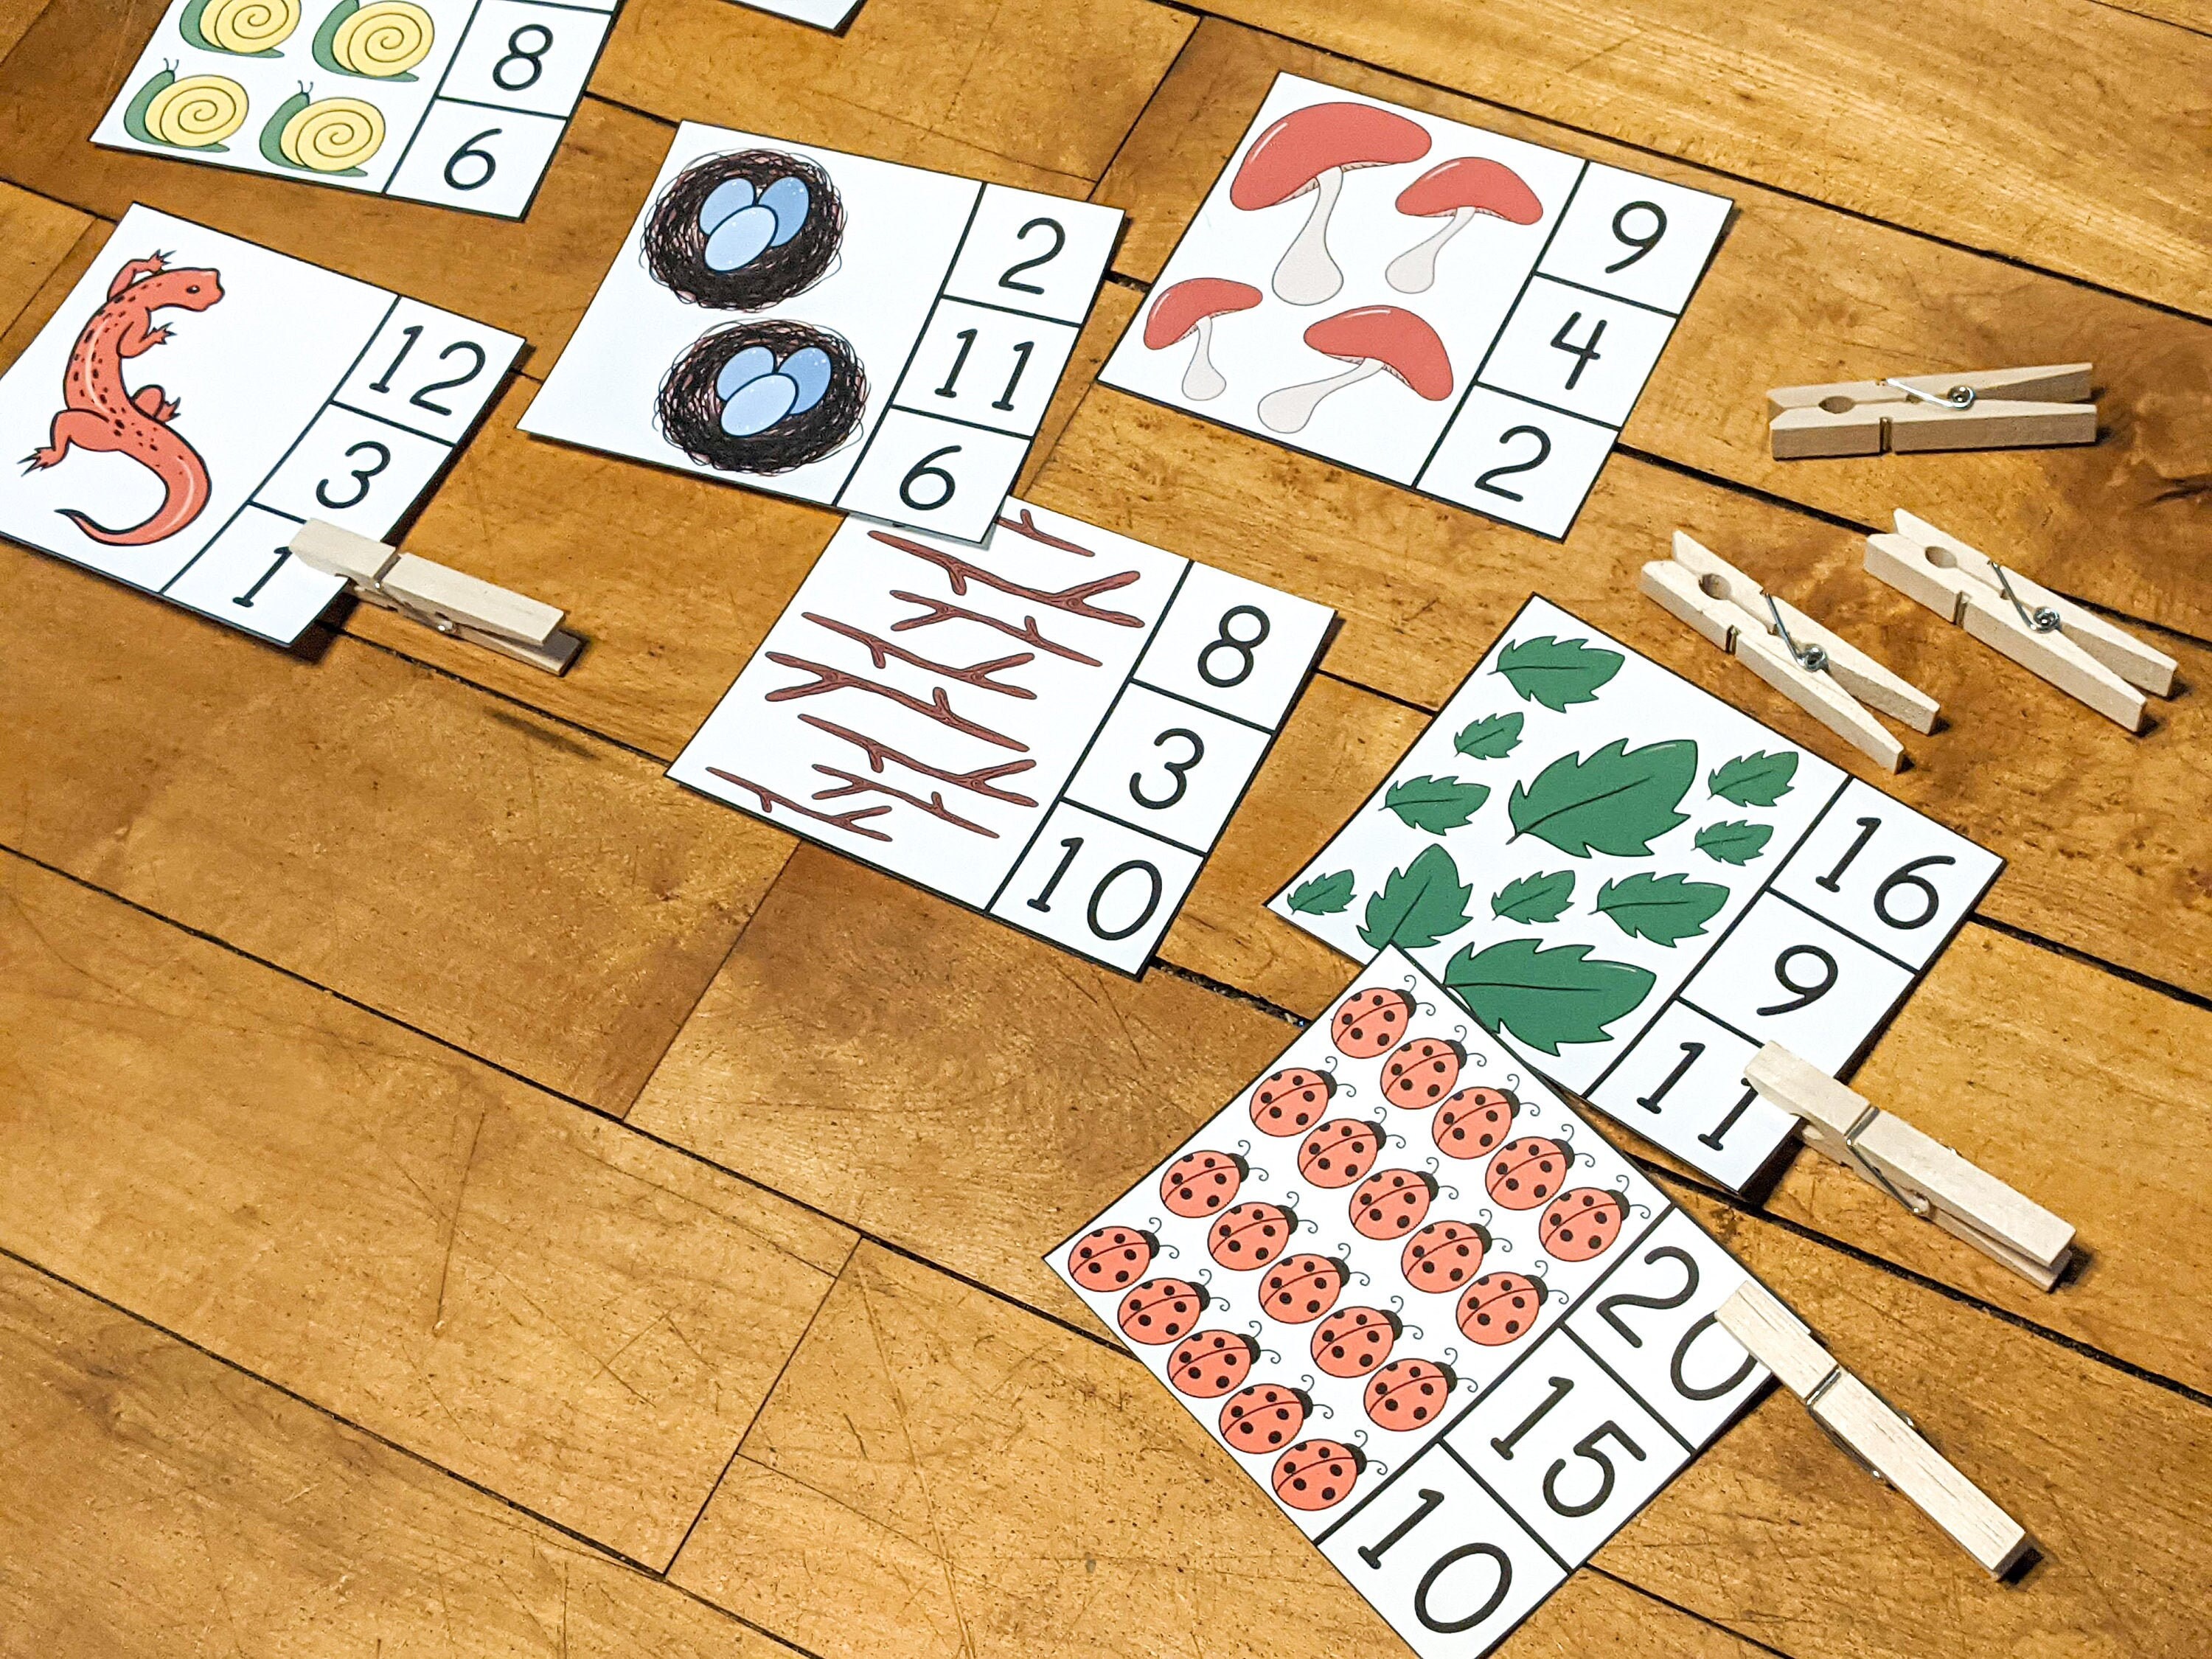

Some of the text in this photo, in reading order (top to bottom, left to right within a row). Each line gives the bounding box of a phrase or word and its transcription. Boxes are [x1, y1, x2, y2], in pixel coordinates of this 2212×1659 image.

[492, 24, 553, 91] 8
[444, 128, 502, 191] 6
[998, 217, 1065, 295] 2
[1605, 201, 1667, 274] 9
[369, 325, 486, 417] 12
[934, 328, 1034, 411] 11
[1550, 311, 1607, 390] 4
[316, 441, 391, 509] 3
[899, 445, 962, 511] 6
[1474, 425, 1551, 502] 2
[232, 546, 293, 608] 1
[1197, 605, 1270, 688] 8
[1129, 728, 1205, 810] 3
[1026, 837, 1163, 941] 10
[1815, 817, 1956, 930] 16
[1756, 945, 1839, 1017] 9
[1636, 1042, 1759, 1152] 11
[1596, 1245, 1759, 1401] 20
[1490, 1376, 1646, 1518] 15
[1357, 1488, 1513, 1634] 10
